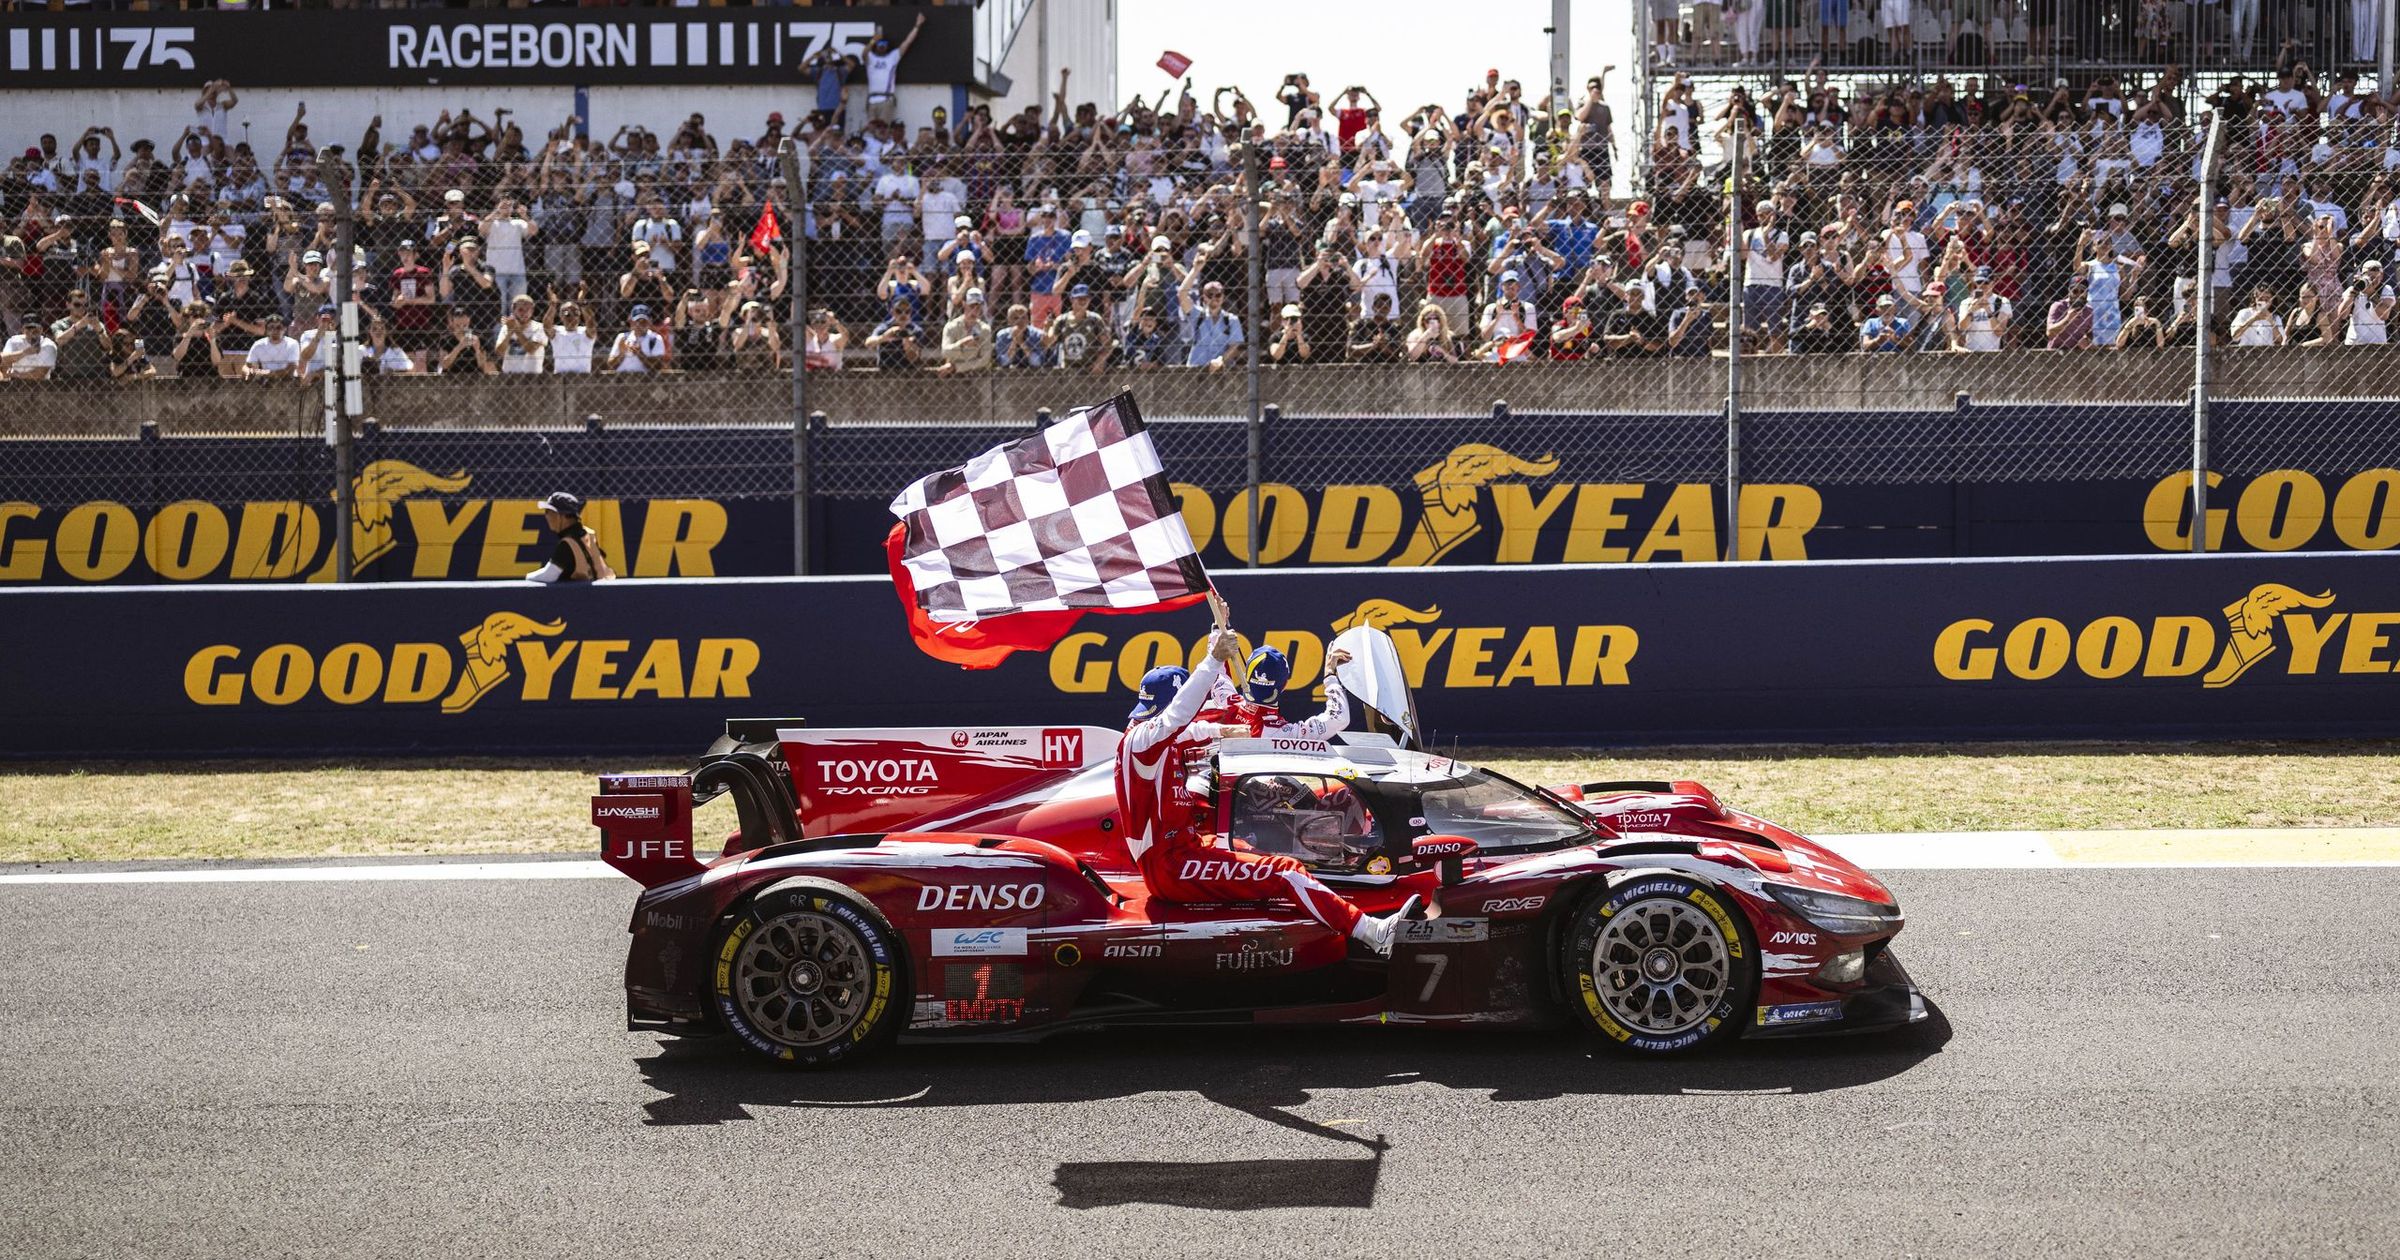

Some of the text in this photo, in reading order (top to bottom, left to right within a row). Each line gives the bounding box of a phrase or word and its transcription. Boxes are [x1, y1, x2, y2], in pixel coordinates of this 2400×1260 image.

[110, 27, 195, 70] 75
[389, 24, 636, 68] RACEBORN
[1044, 734, 1080, 761] HY
[1271, 739, 1327, 752] TOYOTA
[817, 759, 938, 782] TOYOTA
[818, 785, 938, 795] RACING
[596, 807, 660, 817] HAYASHI
[1616, 813, 1671, 827] TOYOTA 7
[616, 840, 685, 859] JFE
[1417, 842, 1461, 855] DENSO
[1179, 859, 1273, 881] DENSO
[917, 883, 1046, 911] DENSO
[1623, 882, 1687, 901] MICHELIN
[1481, 895, 1546, 913] RAYS
[647, 911, 683, 930] Mobil
[837, 905, 885, 958] MICHELIN
[953, 931, 1005, 944] WEC
[1770, 932, 1817, 946] ADVICS
[1103, 945, 1162, 958] AISIN
[1216, 941, 1294, 973] FUJITSU
[974, 963, 992, 1000] 1
[1415, 954, 1448, 1001] 7
[945, 998, 1024, 1021] EMPTY
[1634, 1034, 1699, 1050] MICHELIN
